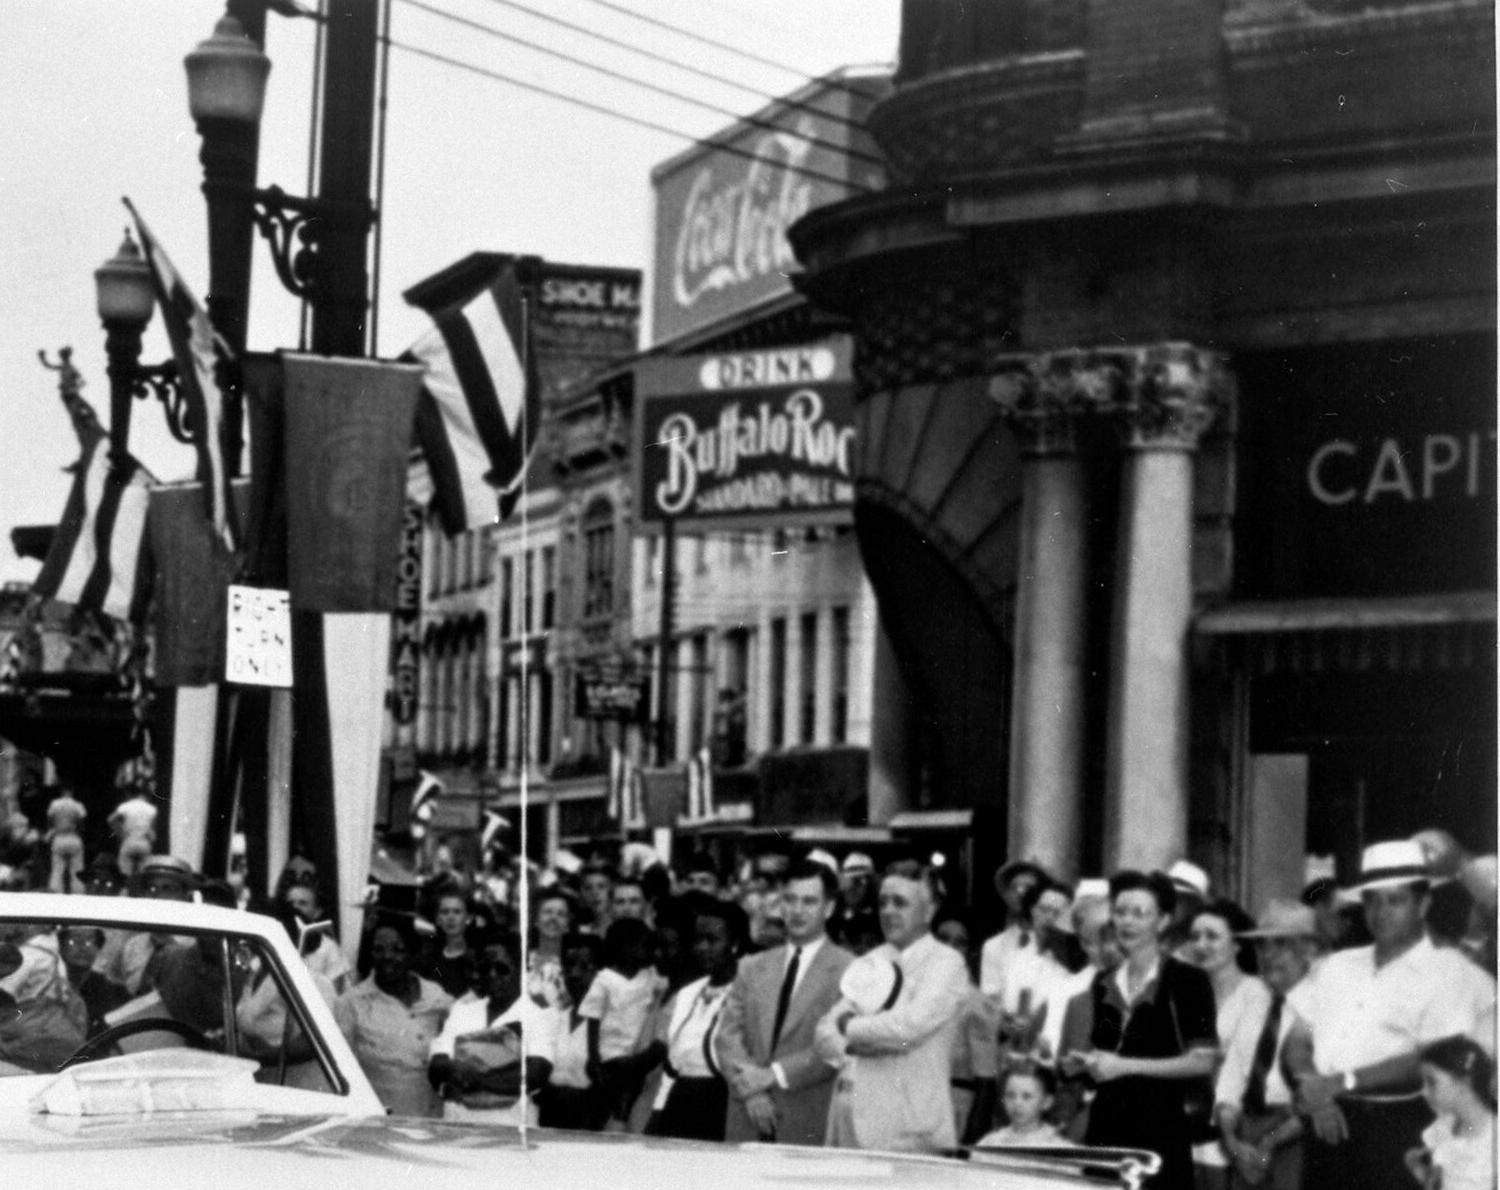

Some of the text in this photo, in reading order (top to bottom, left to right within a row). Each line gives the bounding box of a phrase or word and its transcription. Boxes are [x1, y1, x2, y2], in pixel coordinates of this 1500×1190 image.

[542, 280, 604, 307] SHOE
[720, 349, 814, 385] DRINK
[657, 402, 789, 514] Buffalo
[1306, 430, 1498, 506] CAPI
[399, 504, 423, 610] SHOE
